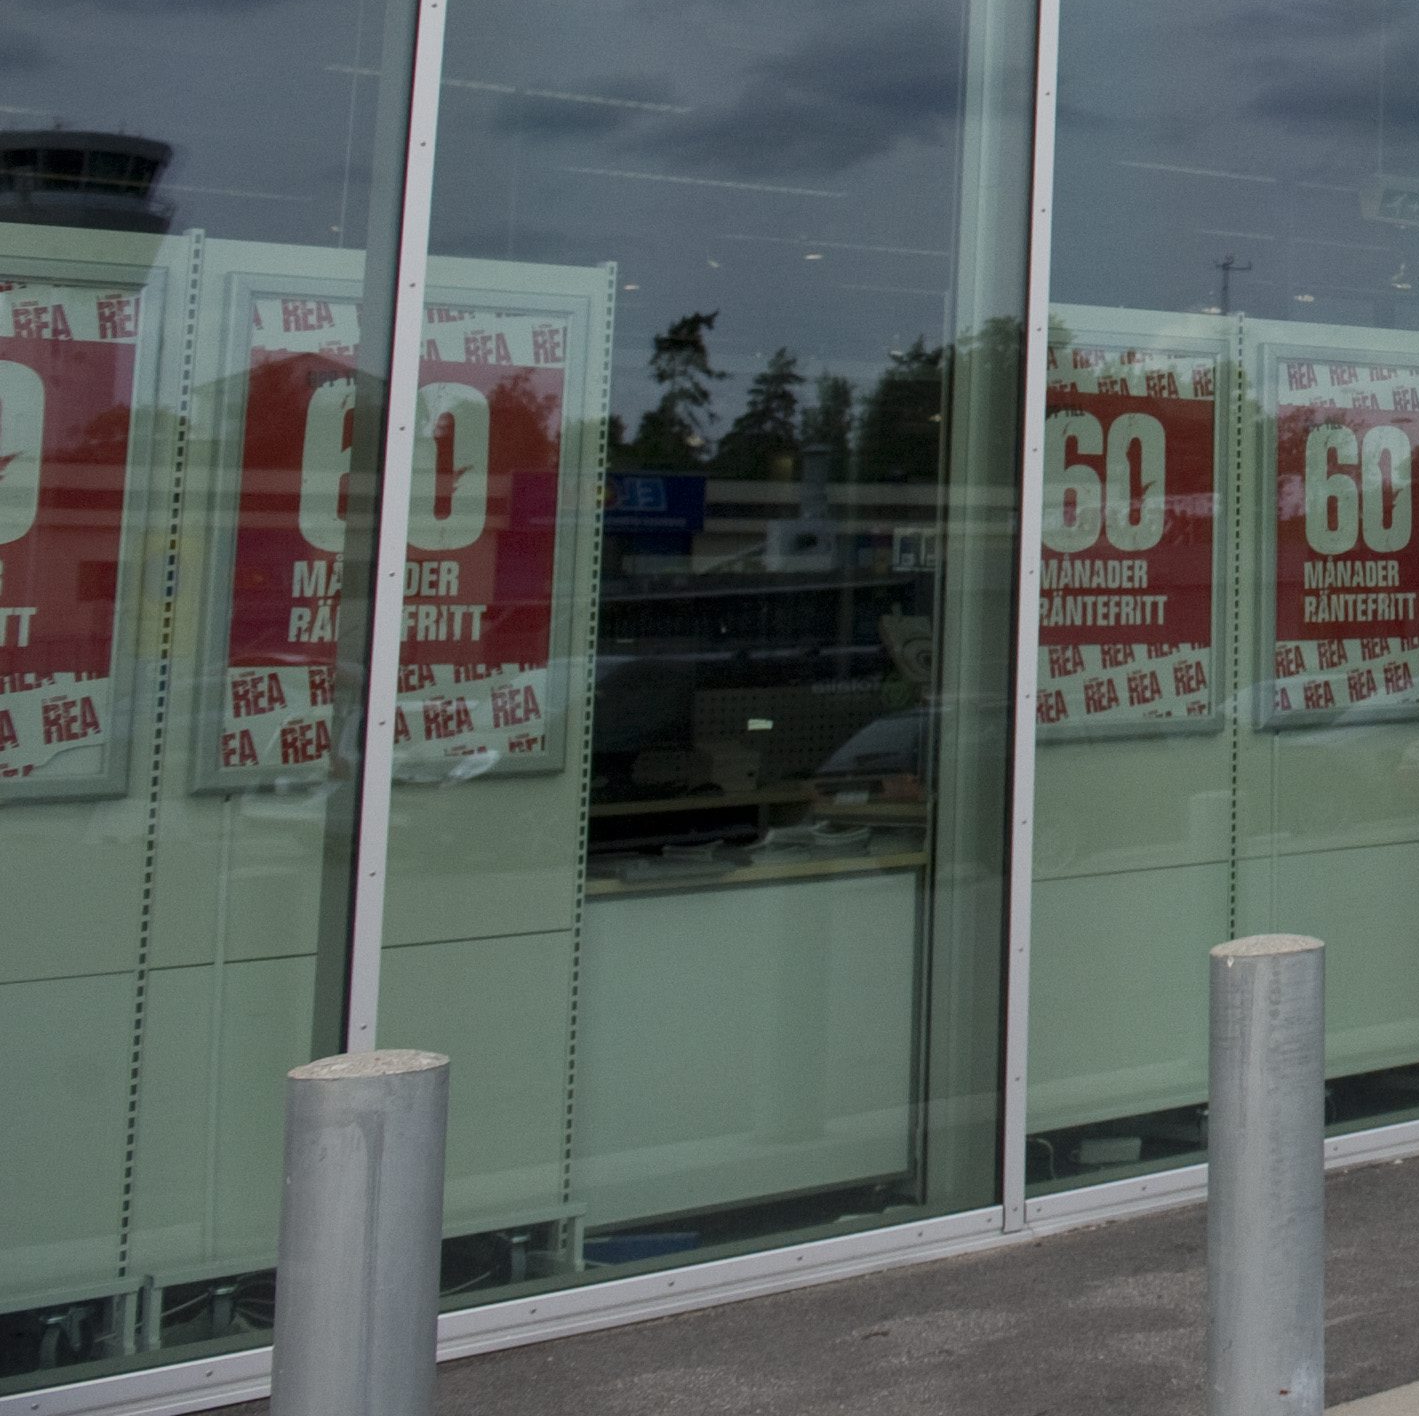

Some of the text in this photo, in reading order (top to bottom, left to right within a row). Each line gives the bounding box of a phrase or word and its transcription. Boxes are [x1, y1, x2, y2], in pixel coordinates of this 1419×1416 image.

[1041, 409, 1167, 553] 60
[1305, 423, 1413, 556] 60
[292, 553, 461, 598] MÅDER
[1040, 552, 1149, 590] MÅNADER
[1303, 555, 1400, 590] MÅNADER
[288, 599, 488, 643] RÄFRITT
[1039, 590, 1169, 627] RÄNTEFRITT
[1304, 590, 1417, 624] RÄNTEFRITT
[231, 671, 287, 719] REA
[1083, 677, 1121, 715] REA
[1126, 670, 1163, 707] REA
[1173, 660, 1208, 697] REA
[42, 696, 102, 745] REA
[422, 684, 542, 741] REA REA
[279, 719, 332, 766] REA
